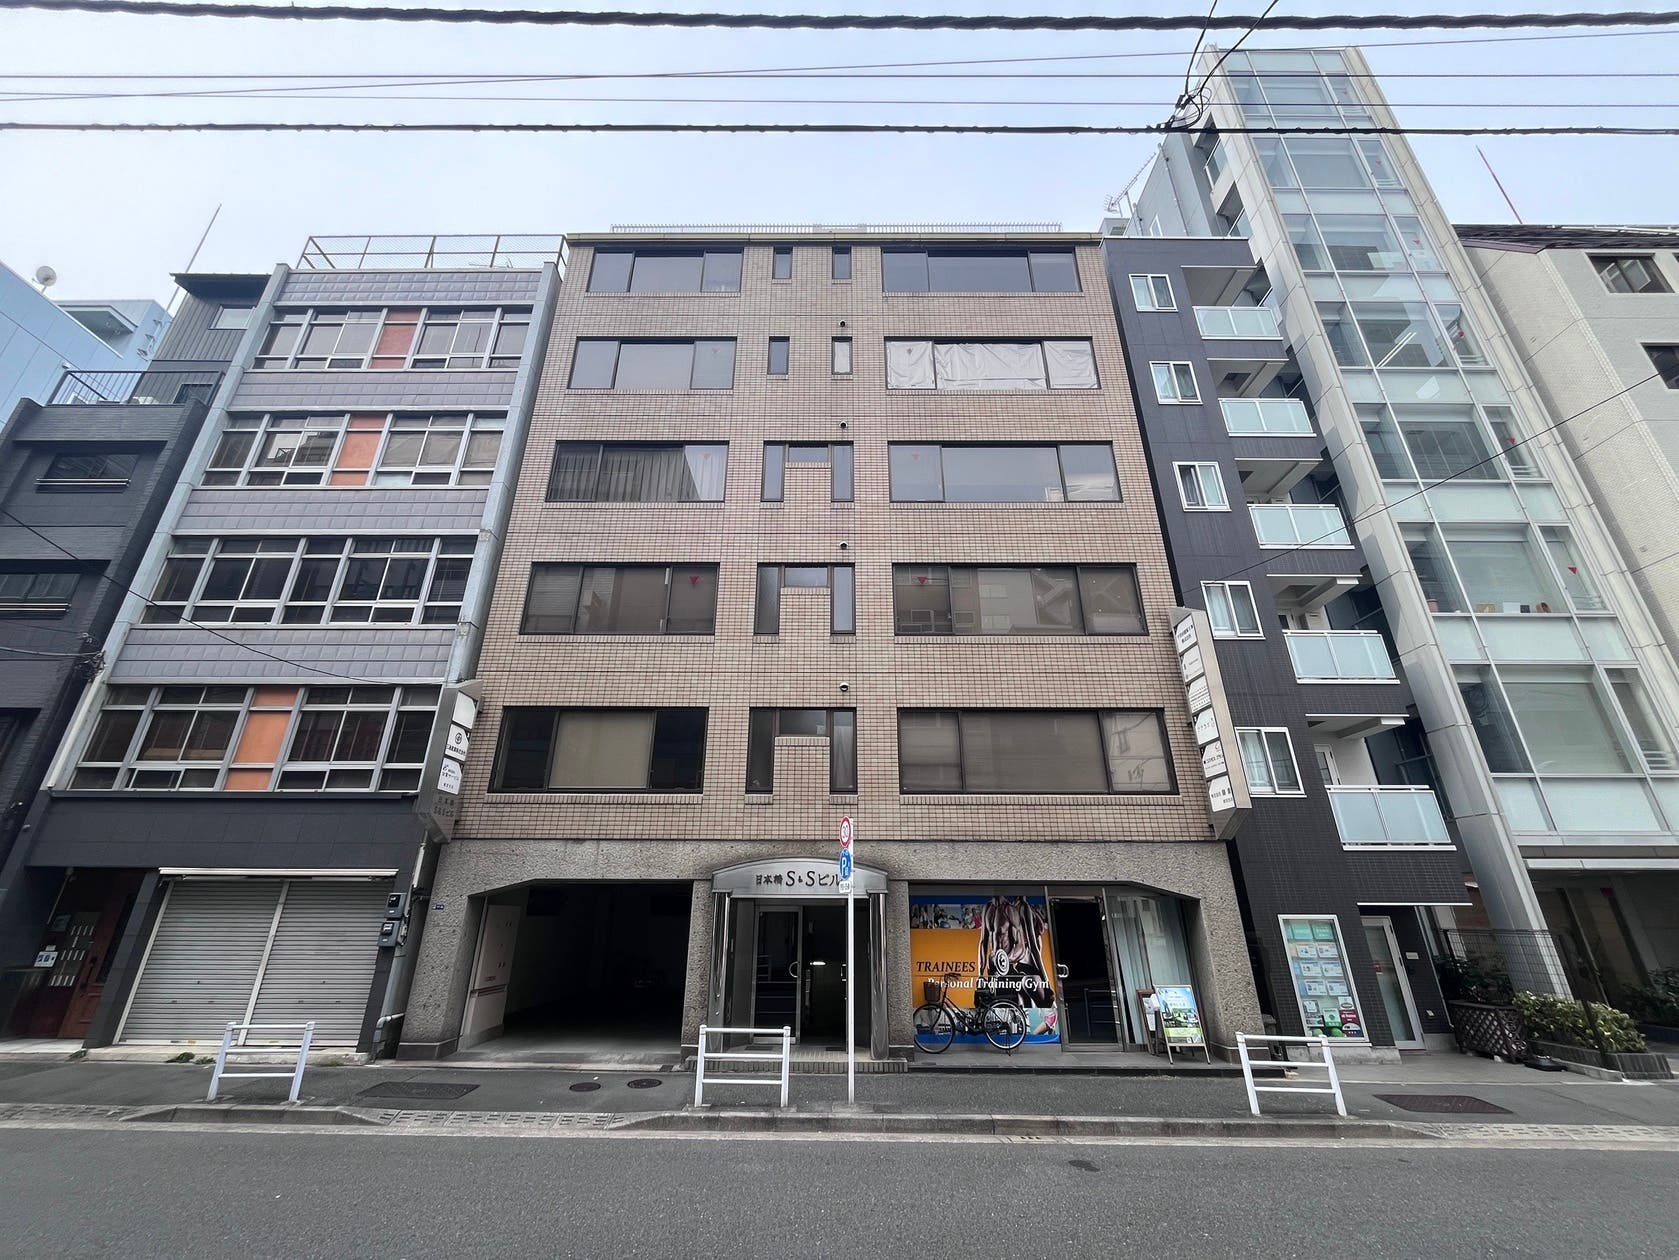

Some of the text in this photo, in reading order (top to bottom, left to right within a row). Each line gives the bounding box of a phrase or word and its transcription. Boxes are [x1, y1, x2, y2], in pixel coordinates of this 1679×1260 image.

[755, 874, 783, 886] 日本橋
[916, 961, 976, 972] TRAINEES
[976, 978, 1023, 992] Training
[1025, 979, 1049, 992] Gym
